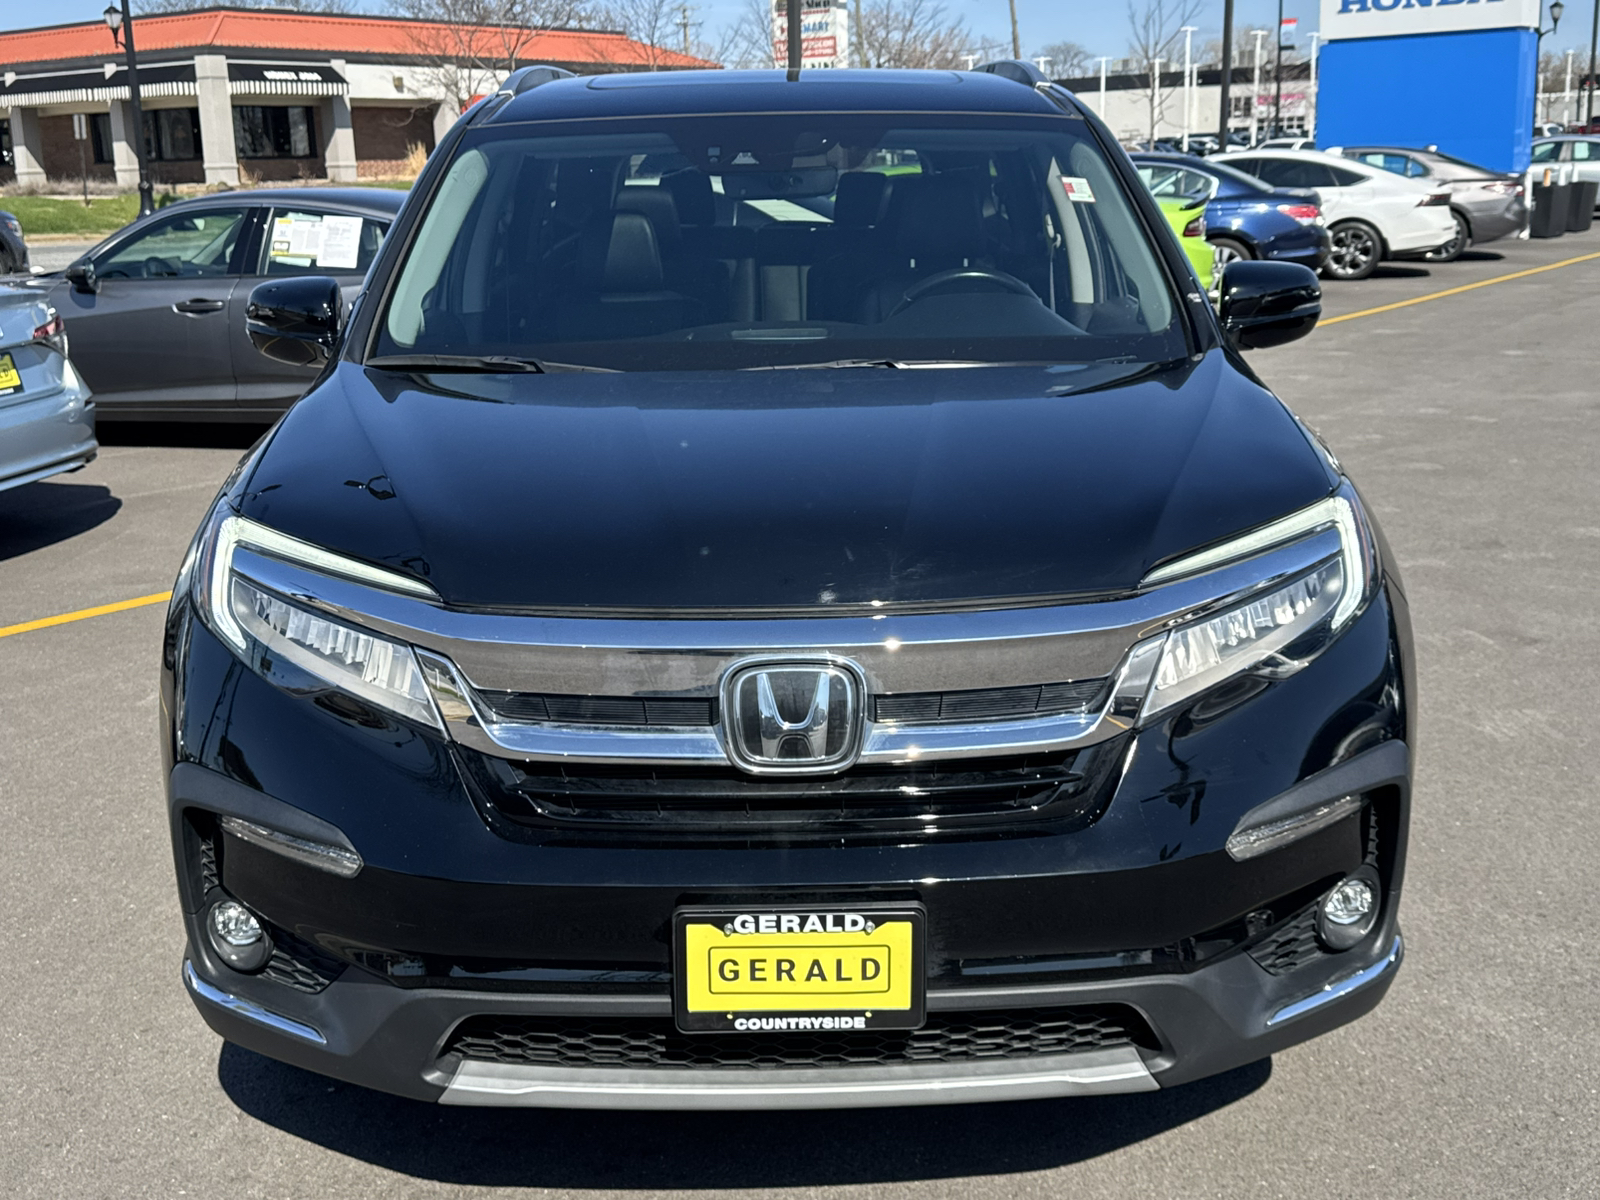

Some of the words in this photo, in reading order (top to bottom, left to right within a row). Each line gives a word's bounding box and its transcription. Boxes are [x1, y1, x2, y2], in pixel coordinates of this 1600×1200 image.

[733, 914, 867, 935] GERALD
[718, 958, 881, 982] GERALD
[734, 1016, 866, 1031] COUNTRYSIDE
